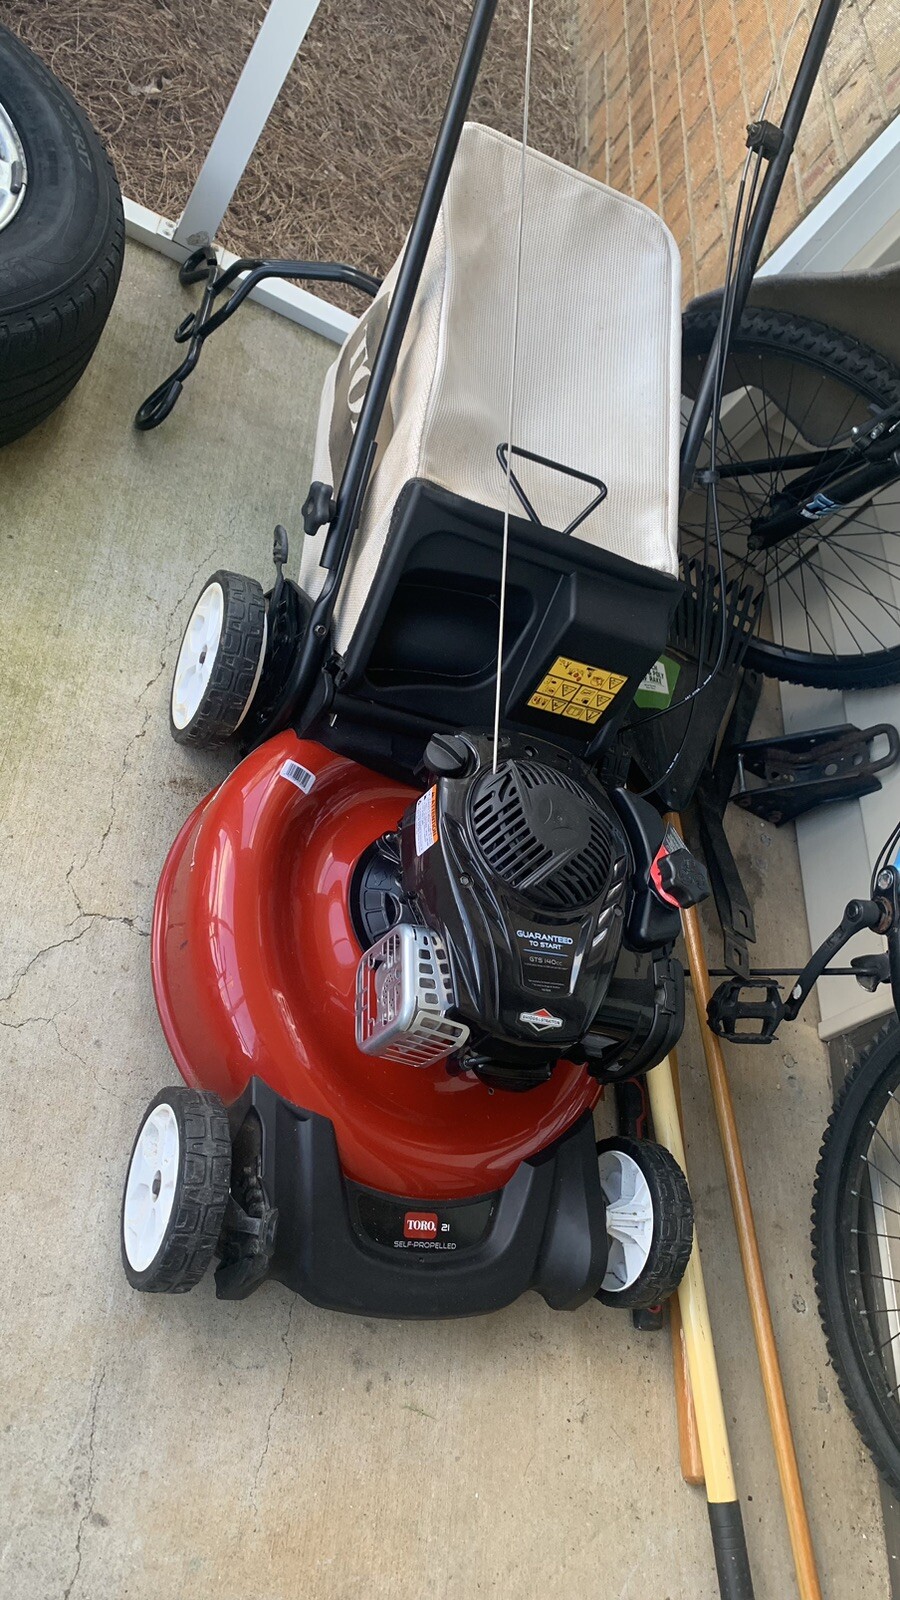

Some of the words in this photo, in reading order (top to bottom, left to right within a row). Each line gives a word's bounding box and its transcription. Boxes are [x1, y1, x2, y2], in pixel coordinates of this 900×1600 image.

[516, 929, 574, 945] GUARANTEED
[540, 942, 561, 950] START
[441, 1223, 450, 1232] 21
[393, 1240, 457, 1250] SELF-PROPELLED
